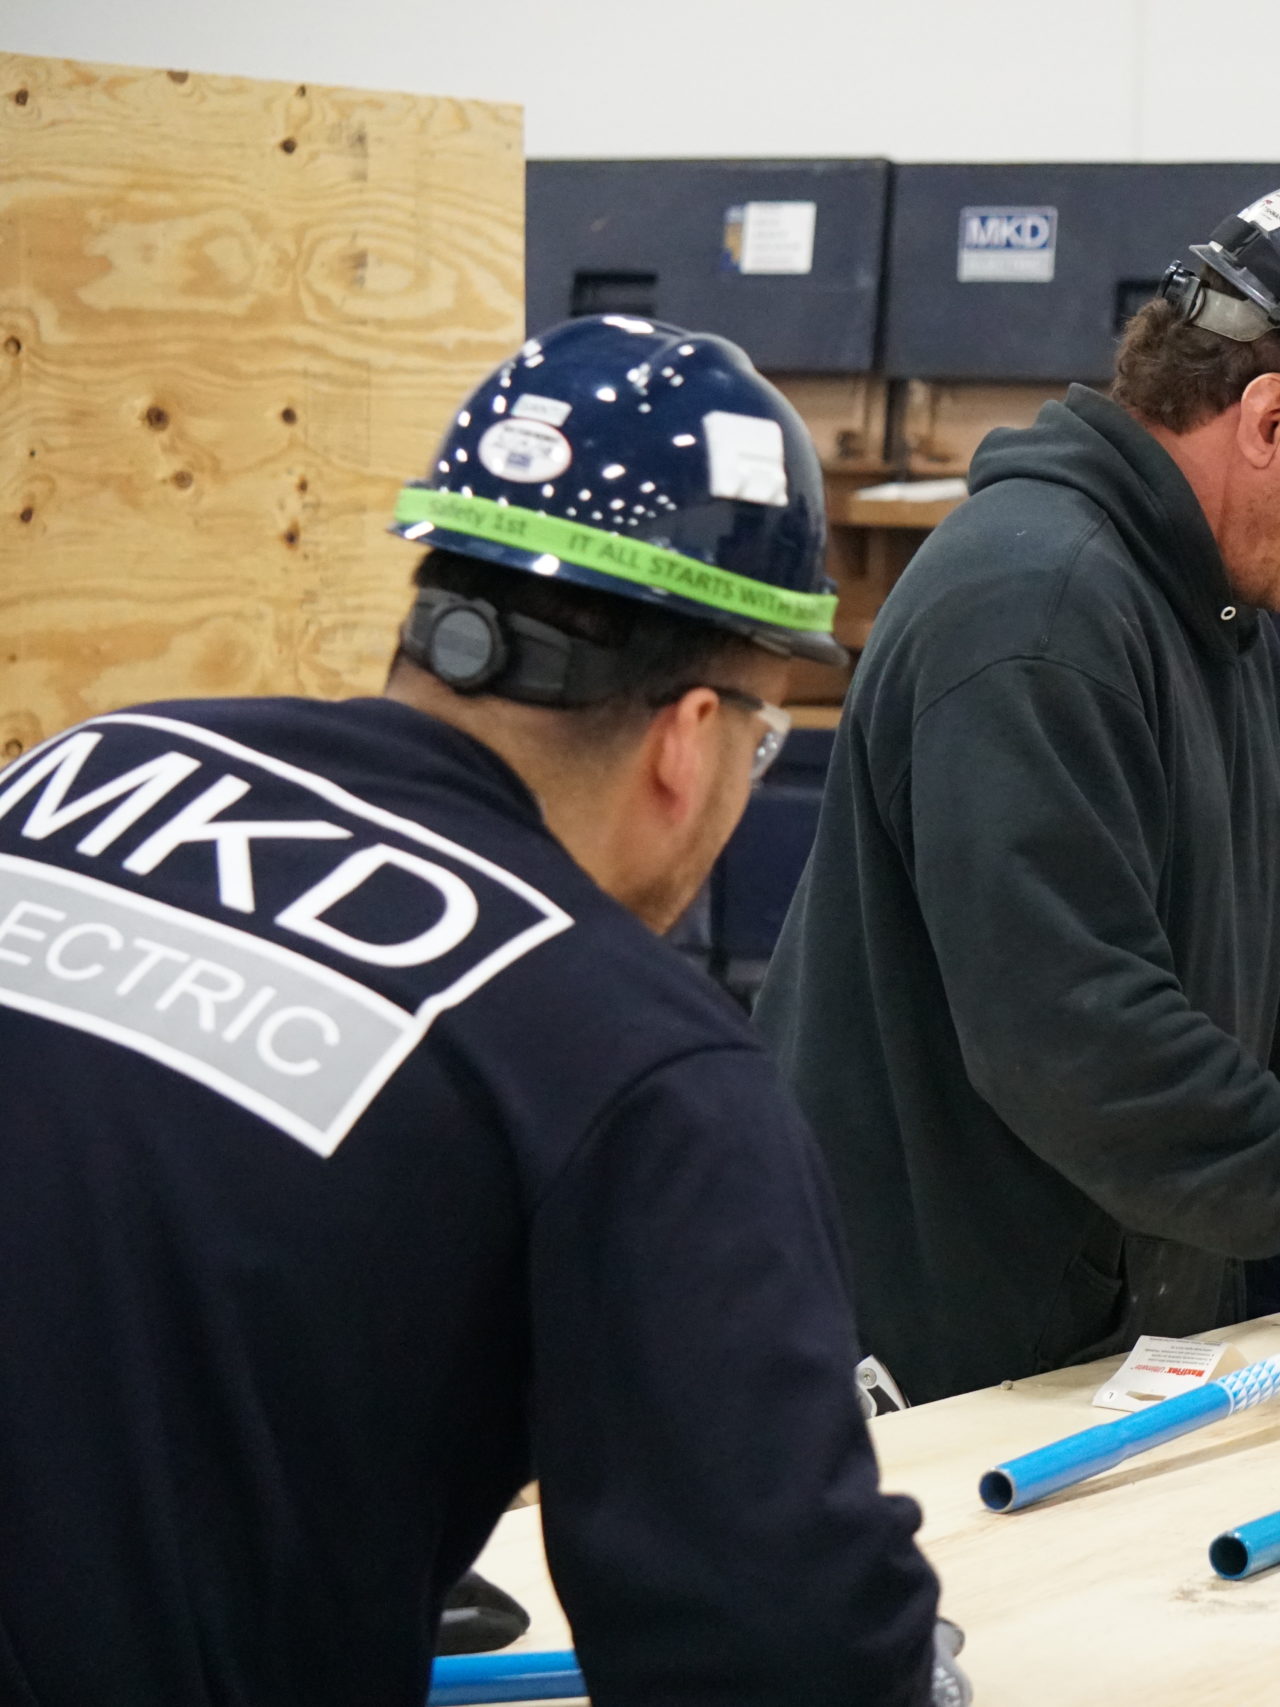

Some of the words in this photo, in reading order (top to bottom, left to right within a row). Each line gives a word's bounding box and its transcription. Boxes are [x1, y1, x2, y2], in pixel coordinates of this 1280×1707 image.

[966, 216, 1050, 249] MKD
[567, 532, 593, 552] IT
[597, 541, 642, 570] ALL
[648, 555, 735, 600] STARTS
[0, 731, 479, 968] MKD
